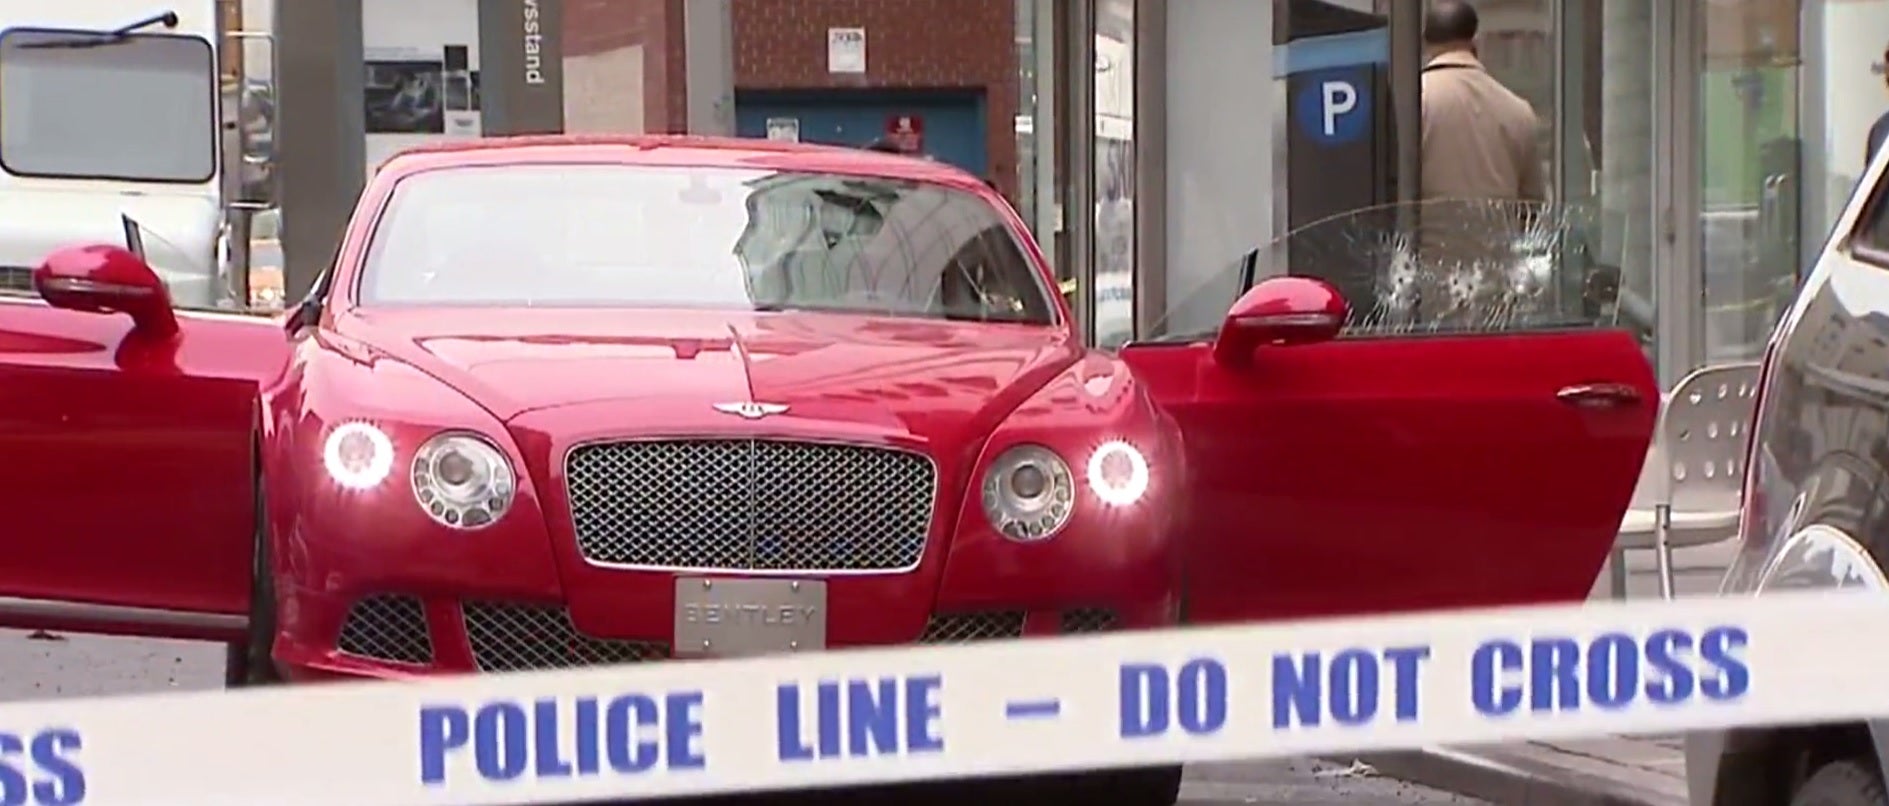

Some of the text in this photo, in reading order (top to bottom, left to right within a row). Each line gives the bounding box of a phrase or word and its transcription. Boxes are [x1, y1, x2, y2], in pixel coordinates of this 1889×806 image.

[1323, 81, 1356, 135] P
[685, 602, 816, 624] BENTLEY
[419, 692, 705, 786] POLICE
[777, 676, 943, 762] LINE
[1120, 658, 1229, 739] DO
[1272, 646, 1430, 730] NOT
[1471, 625, 1751, 718] CROSS
